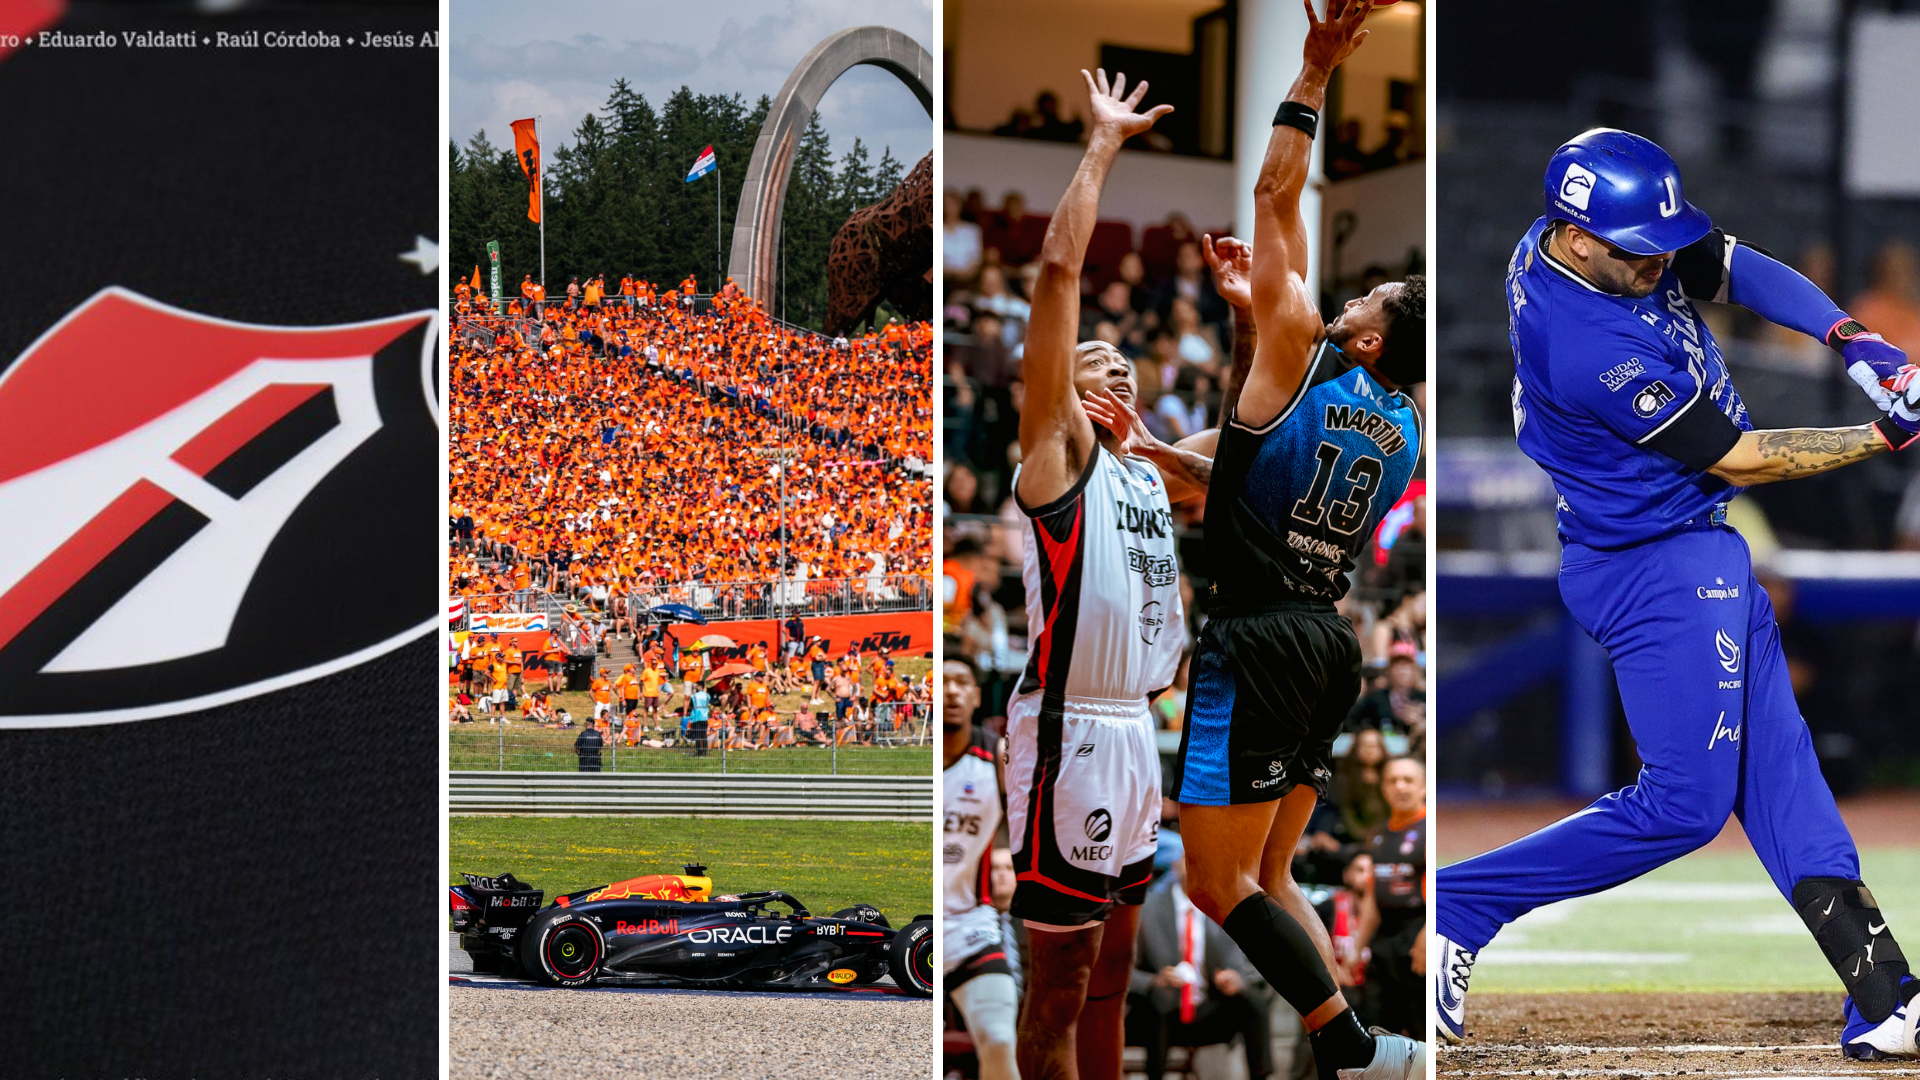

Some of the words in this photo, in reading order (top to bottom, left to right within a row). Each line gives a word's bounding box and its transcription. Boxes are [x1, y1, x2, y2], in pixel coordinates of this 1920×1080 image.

[38, 31, 117, 48] Eduardo
[122, 31, 197, 48] Valdatti
[216, 31, 259, 48] Raúl
[263, 31, 341, 48] Córdoba
[360, 31, 414, 48] Jesús
[1659, 175, 1678, 219] J
[1554, 200, 1591, 224] caliente.mx
[1598, 357, 1640, 383] CIUDAD
[1605, 364, 1645, 390] MADERAS
[1291, 440, 1384, 536] 13
[1286, 530, 1347, 565] TOSCANAS
[1697, 586, 1727, 601] Campo
[1728, 585, 1739, 598] Azul
[861, 632, 911, 652] KTM
[491, 896, 527, 907] Mobil
[496, 926, 517, 935] Player
[617, 919, 647, 935] Red
[650, 919, 679, 935] Bull
[688, 926, 792, 944] ORACLE
[816, 922, 846, 936] BYBIT
